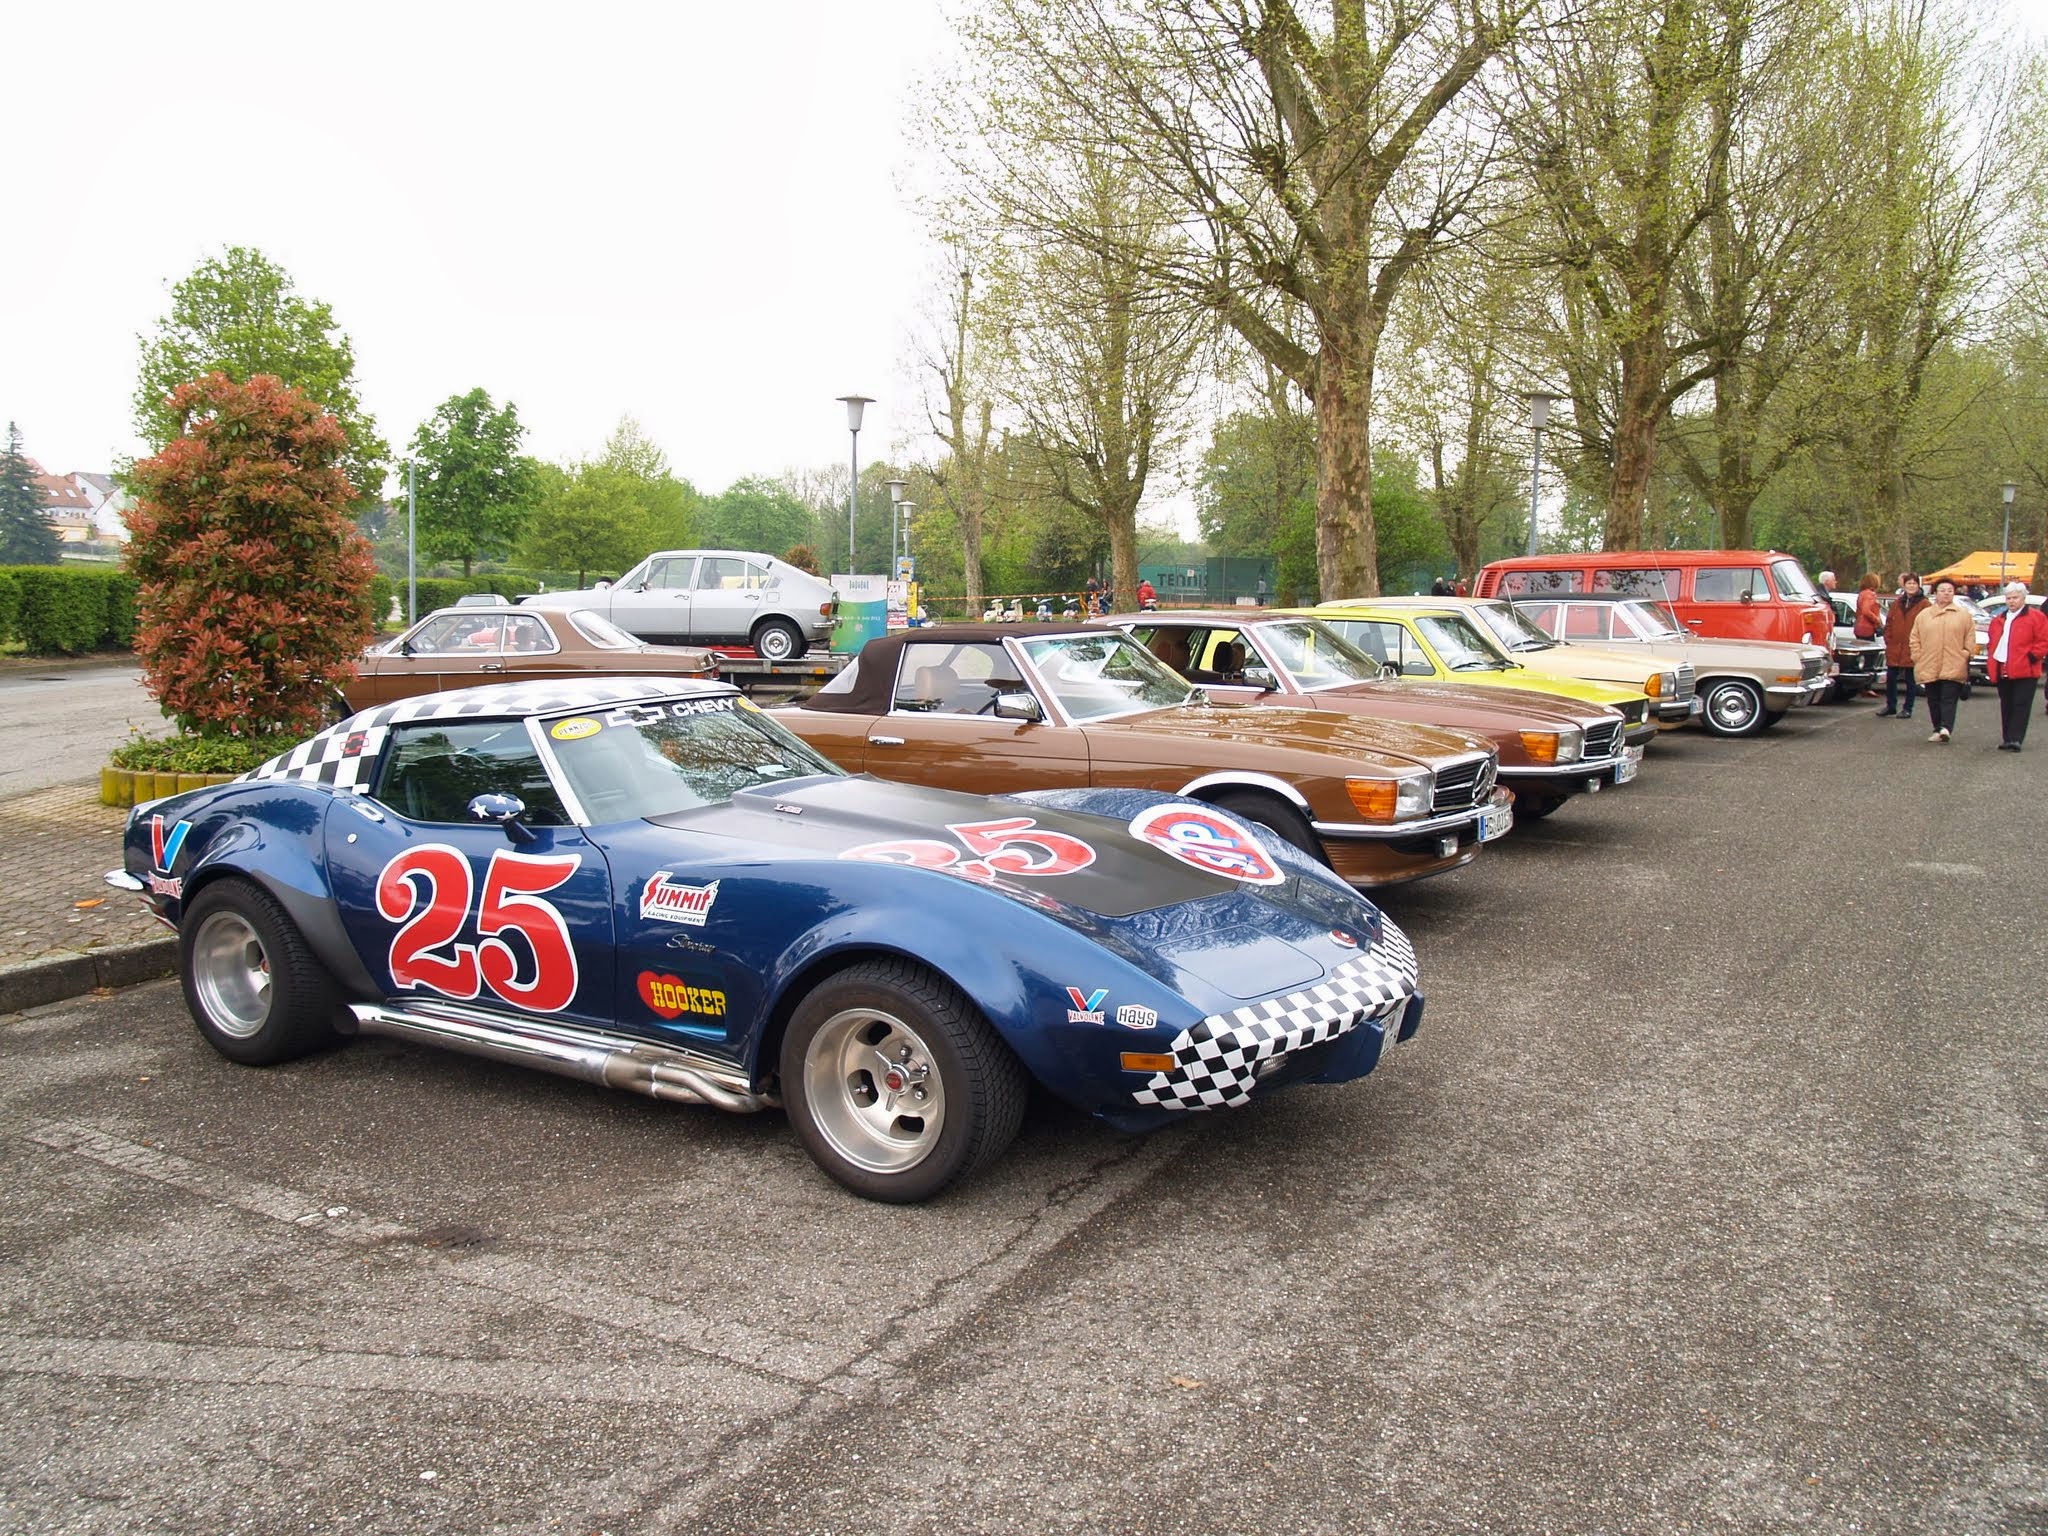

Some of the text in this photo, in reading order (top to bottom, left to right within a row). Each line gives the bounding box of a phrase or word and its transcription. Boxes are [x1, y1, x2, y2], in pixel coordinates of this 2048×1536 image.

[672, 698, 736, 717] CHEVY
[643, 876, 712, 911] SUMMIT
[375, 843, 583, 1013] 25
[649, 981, 727, 1016] HOOKER
[1067, 1011, 1104, 1025] VALVOLINE
